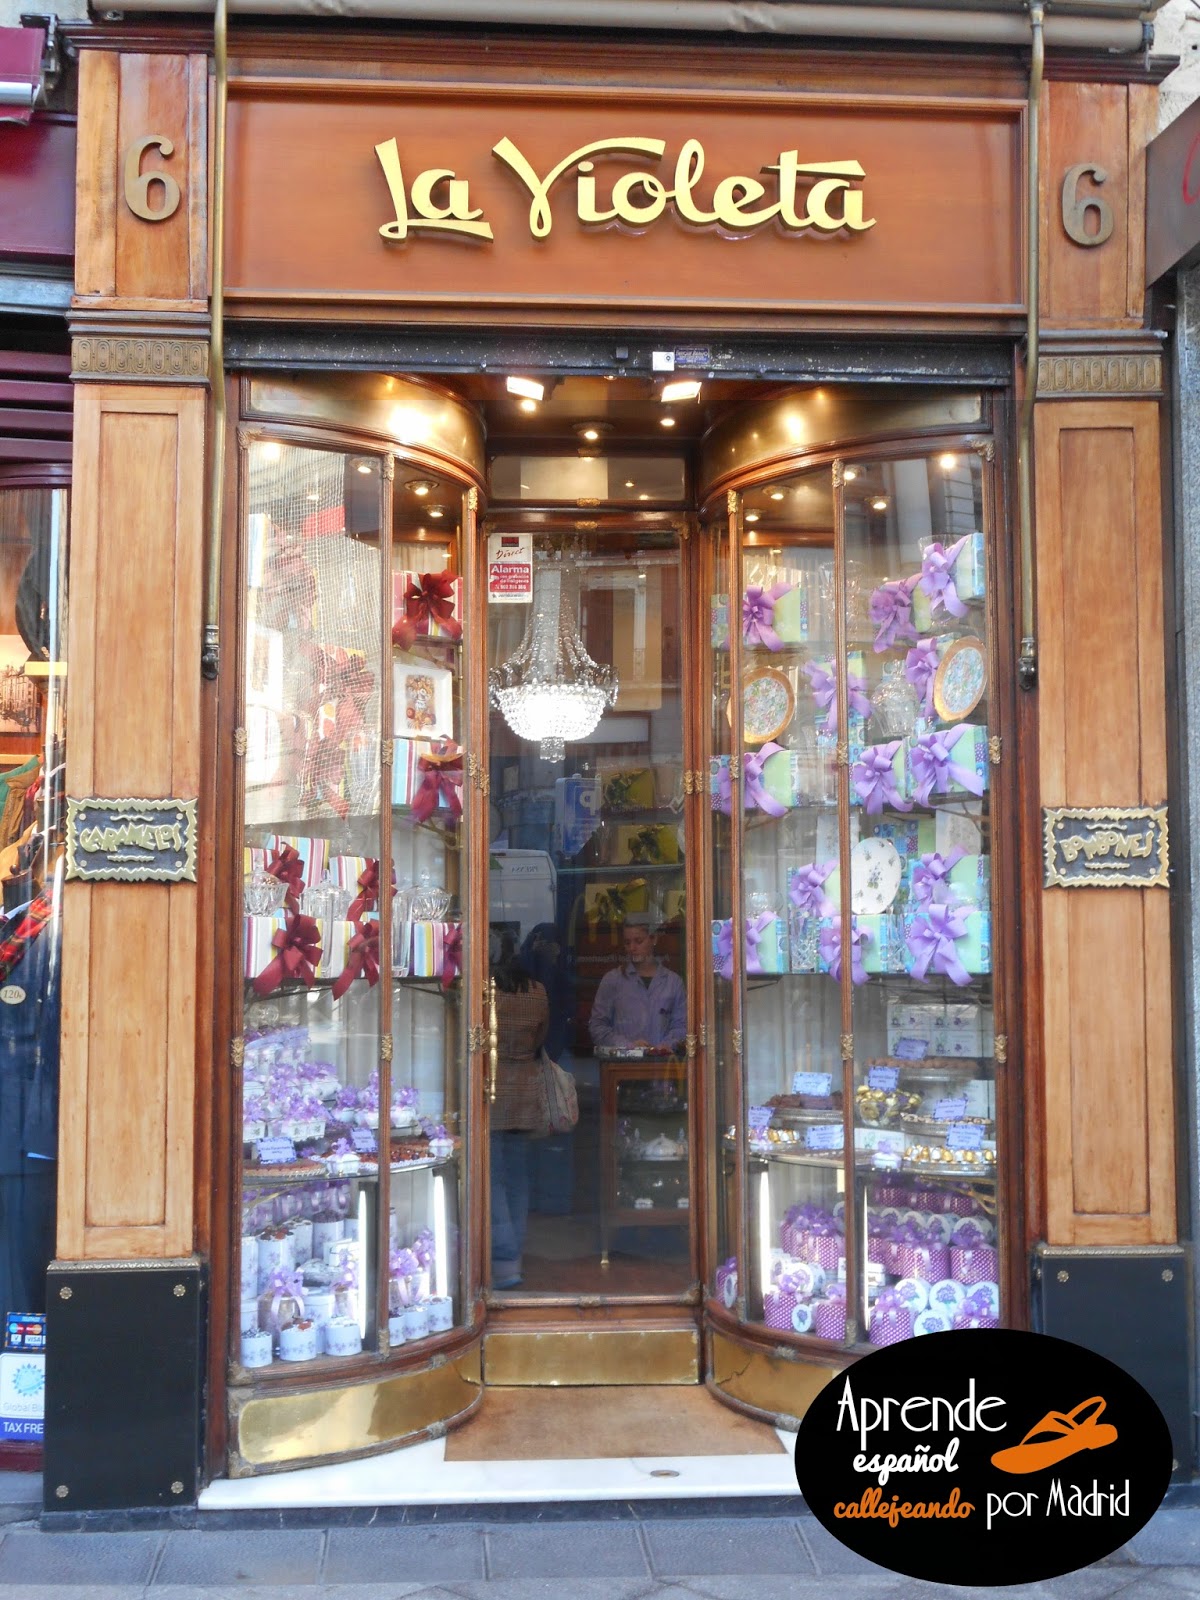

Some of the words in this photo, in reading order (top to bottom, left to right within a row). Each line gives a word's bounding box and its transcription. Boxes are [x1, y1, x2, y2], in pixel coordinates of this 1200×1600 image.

[124, 134, 182, 223] 6
[374, 136, 494, 244] La
[492, 136, 877, 242] Violeta
[1062, 162, 1115, 247] 6
[490, 565, 530, 574] Alarma
[496, 547, 525, 560] Direct
[79, 822, 183, 853] CARAMELOS
[1059, 830, 1154, 863] BOMBONES
[3, 1421, 23, 1433] TAX
[24, 1422, 44, 1434] FRE
